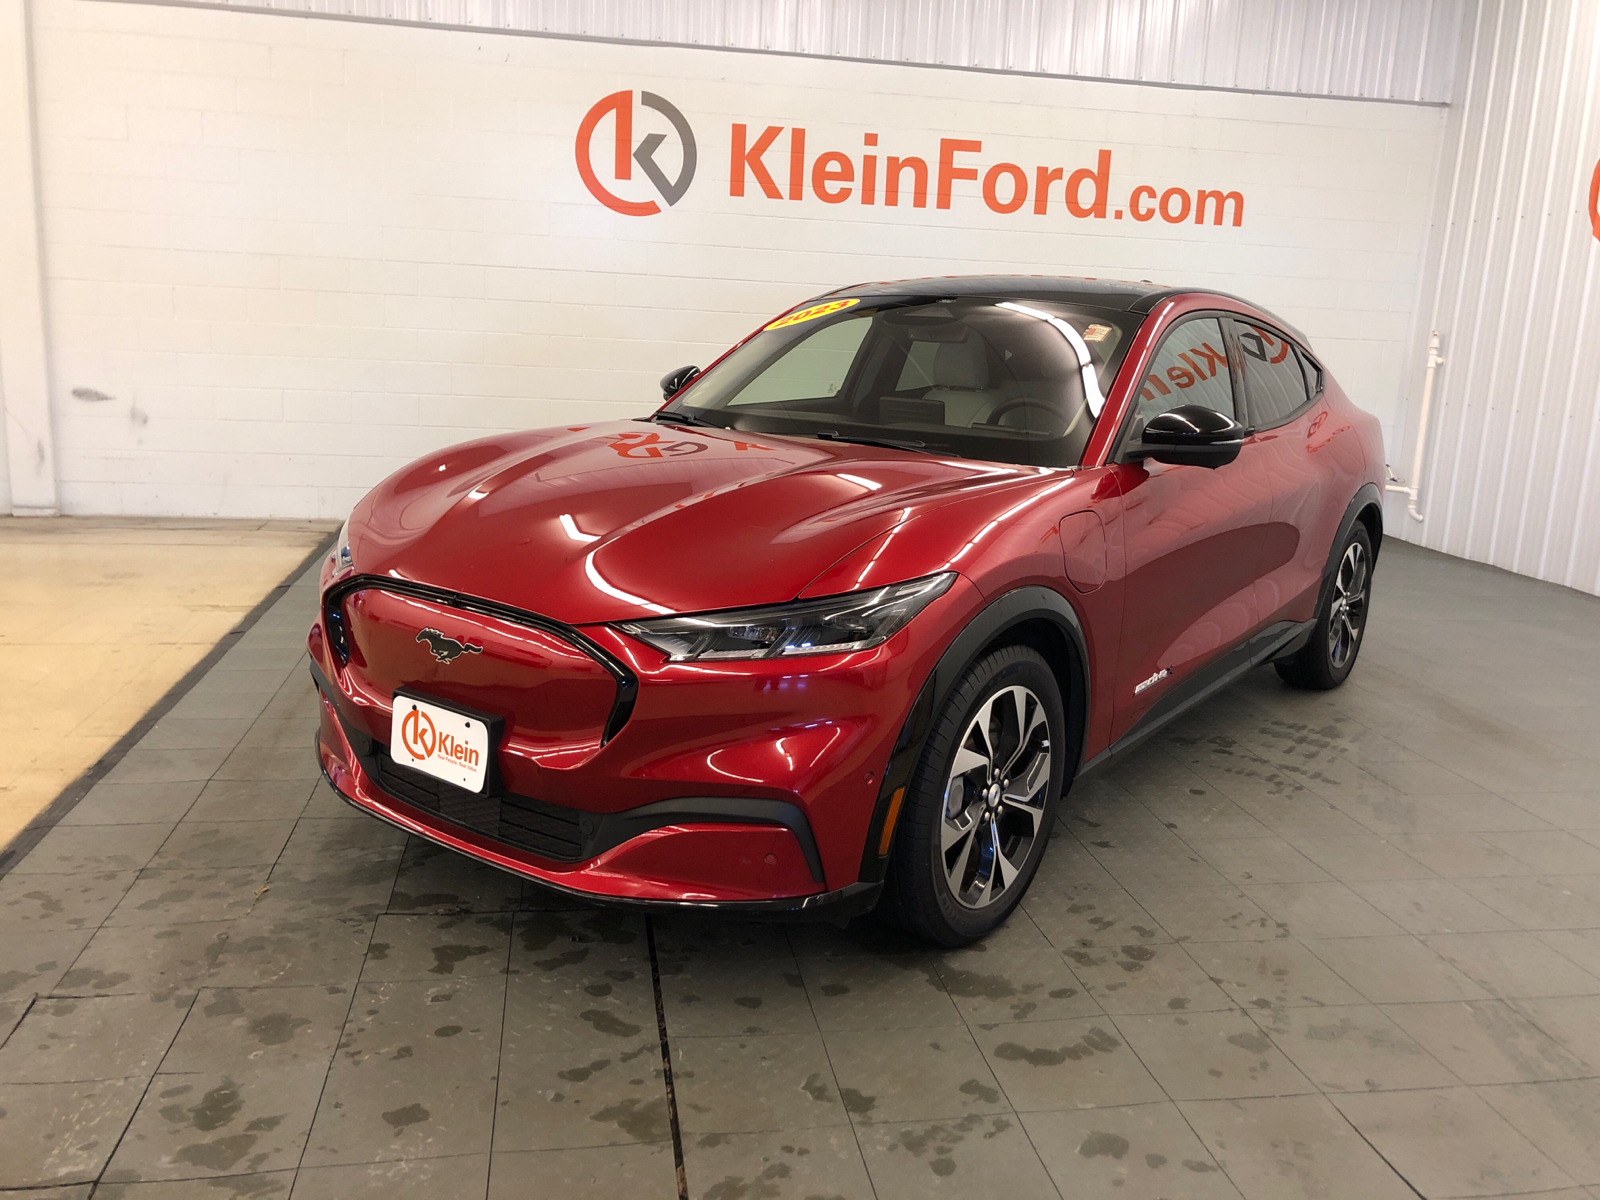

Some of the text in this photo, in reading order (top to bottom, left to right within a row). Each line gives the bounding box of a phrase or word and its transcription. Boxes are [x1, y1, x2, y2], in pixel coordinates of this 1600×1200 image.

[730, 123, 1244, 227] KleinFord.com
[772, 300, 850, 328] 2023
[438, 731, 480, 767] Klein
